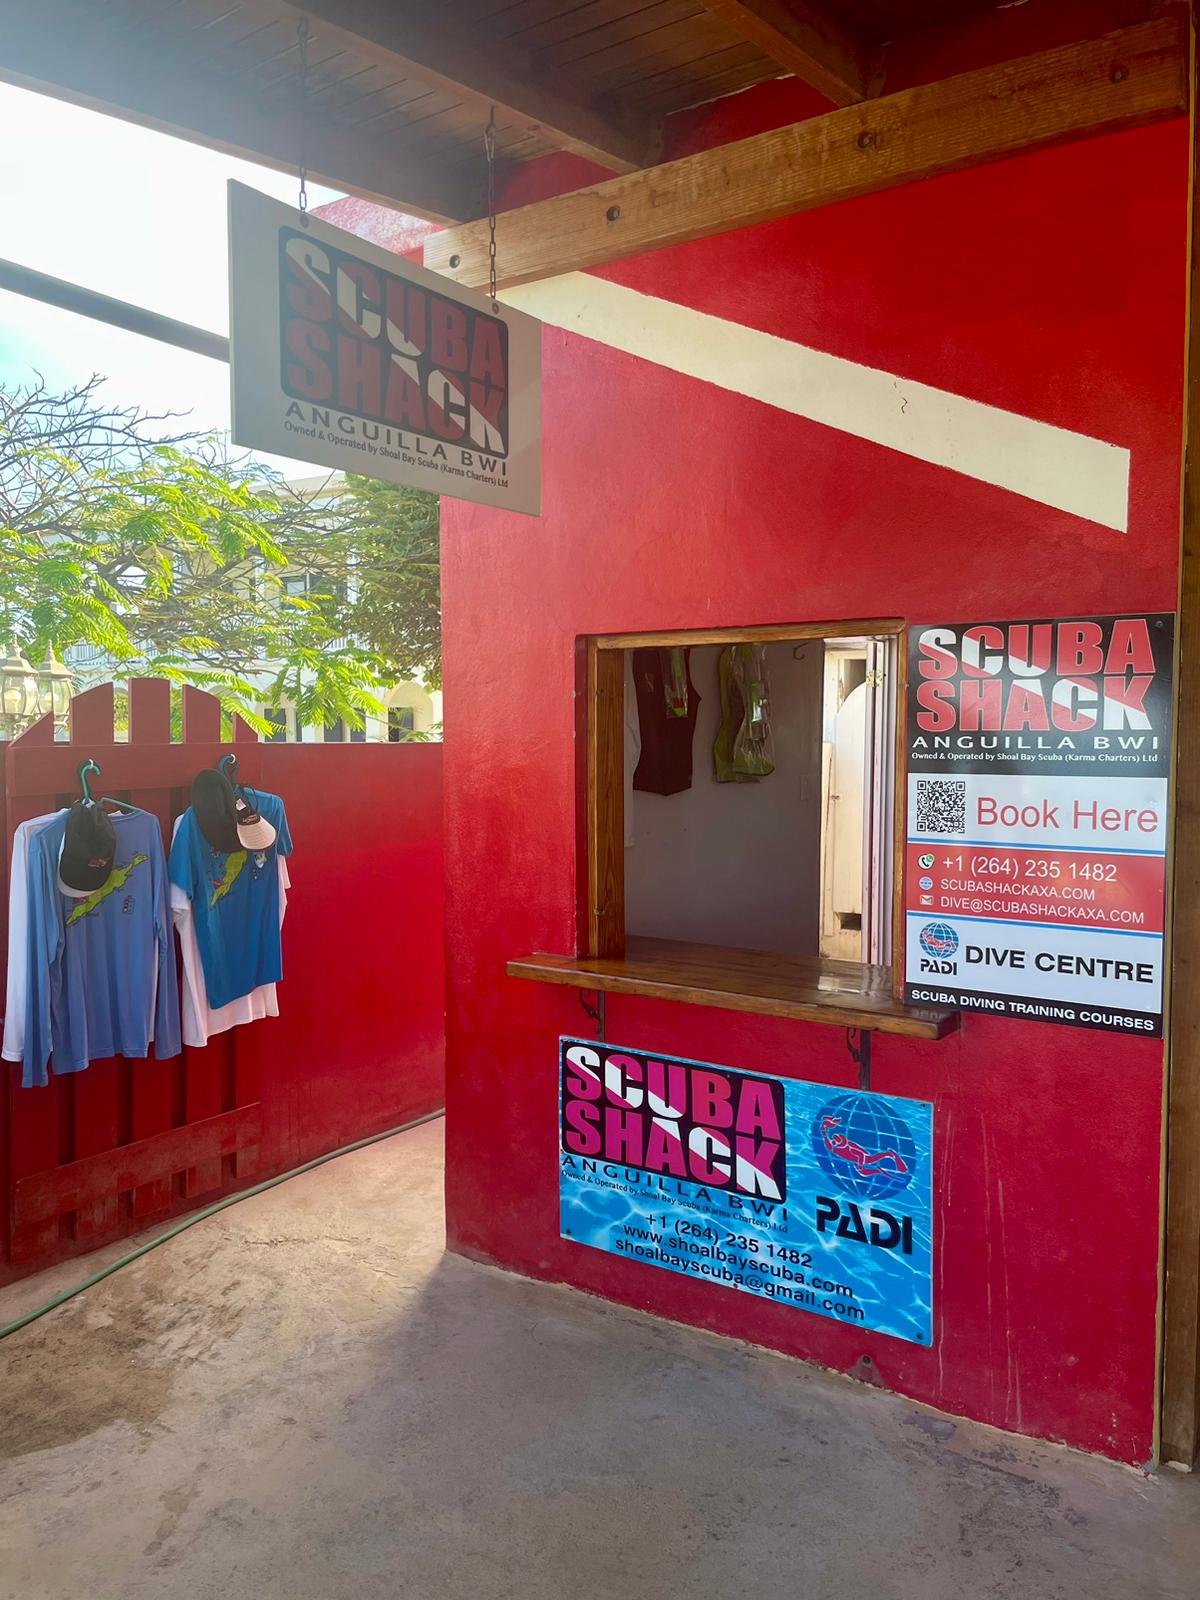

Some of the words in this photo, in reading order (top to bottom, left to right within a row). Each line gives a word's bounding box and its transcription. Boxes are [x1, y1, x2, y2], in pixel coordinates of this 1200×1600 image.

[285, 237, 504, 384] SCUBA
[285, 318, 506, 455] SHACK
[284, 421, 316, 437] Owned
[318, 431, 326, 440] &
[327, 432, 366, 452] Operated
[369, 442, 378, 455] by
[380, 447, 400, 460] Shoal
[402, 453, 416, 466] Bay
[417, 458, 439, 470] Scuba
[440, 463, 465, 477] (Karma
[466, 470, 497, 487] Charters)
[497, 478, 508, 488] Ltd
[285, 401, 448, 460] ANGUILLA
[461, 450, 506, 476] BWI
[918, 618, 1156, 680] SCUBA
[916, 675, 1154, 732] SHACK
[911, 752, 938, 760] Owned
[947, 752, 983, 762] Operated
[985, 752, 994, 762] by
[997, 752, 1018, 761] Shoal
[1020, 753, 1037, 762] Bay
[1038, 753, 1063, 761] Scuba
[1065, 753, 1096, 763] (Karma
[1098, 753, 1140, 764] Charters)
[1142, 754, 1158, 762] Ltd
[912, 735, 1076, 749] ANGUILLA
[1093, 736, 1158, 750] BWI
[976, 797, 1060, 829] Book
[1072, 799, 1158, 833] Here
[940, 878, 1096, 901] SCUBASHACKAXA.COM
[942, 855, 963, 873] +1
[970, 855, 1020, 880] (264)
[1024, 859, 1061, 879] 235
[1069, 862, 1118, 883] 1482
[940, 896, 1145, 924] DIVE@SCUBASHACKAXA.COM
[920, 958, 958, 976] PADI
[965, 945, 1026, 969] DIVE
[1034, 952, 1154, 984] CENTRE
[911, 989, 957, 1004] SCUBA
[960, 995, 1006, 1011] DIVING
[1009, 1001, 1076, 1020] TRAINING
[1079, 1010, 1155, 1031] COURSES
[565, 1046, 782, 1142] SCUBA
[565, 1100, 783, 1200] SHACK
[561, 1169, 586, 1181] Owned
[594, 1178, 628, 1192] Operated
[629, 1186, 638, 1196] by
[640, 1189, 660, 1200] Shoal
[662, 1194, 676, 1205] Bay
[678, 1198, 700, 1211] Scuba
[702, 1205, 731, 1218] (Karma
[732, 1212, 772, 1230] Charters)
[773, 1223, 788, 1233] Ltd
[562, 1155, 712, 1202] ANGUILLA
[728, 1194, 787, 1221] BWI
[645, 1214, 666, 1229] +1
[674, 1218, 719, 1245] (264)
[725, 1232, 760, 1253] 235
[766, 1242, 813, 1269] 1482
[816, 1194, 913, 1255] PADI
[615, 1238, 865, 1321] shoalbayscuba@gmail.com
[623, 1224, 854, 1297] www.shoalbayscuba.com
